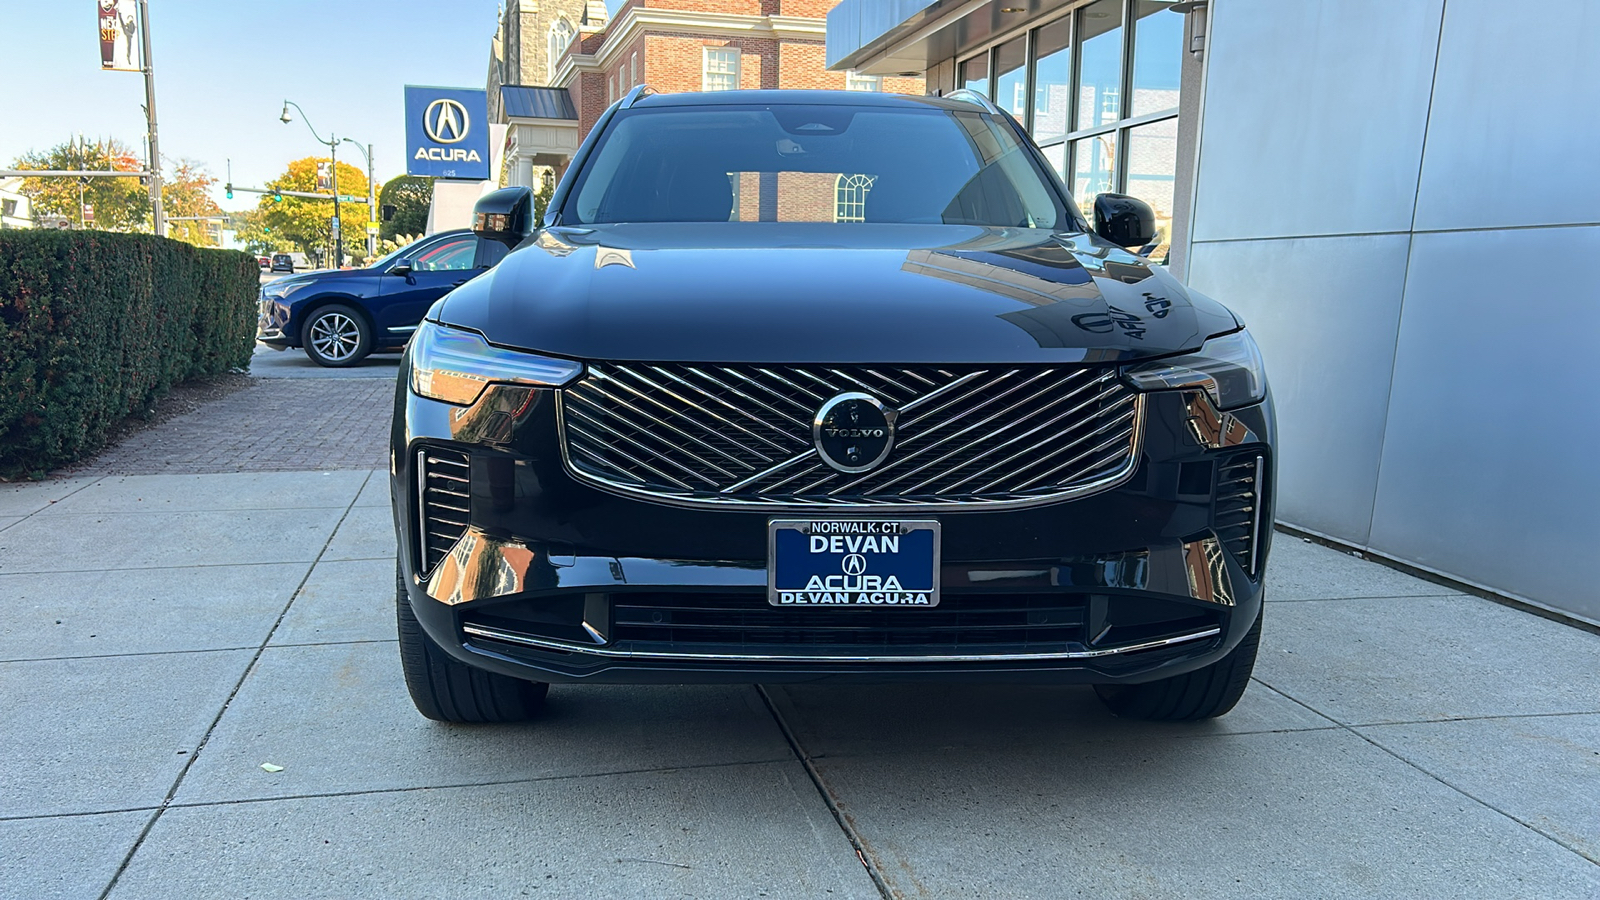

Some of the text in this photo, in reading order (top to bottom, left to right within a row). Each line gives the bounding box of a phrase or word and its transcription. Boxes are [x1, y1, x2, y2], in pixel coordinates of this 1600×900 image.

[414, 147, 481, 163] ACURA
[443, 169, 456, 177] 625
[825, 428, 884, 438] VOLVO
[881, 522, 899, 533] CT
[810, 535, 899, 553] DEVAN
[804, 575, 903, 591] ACURA
[780, 592, 849, 604] DEVAN
